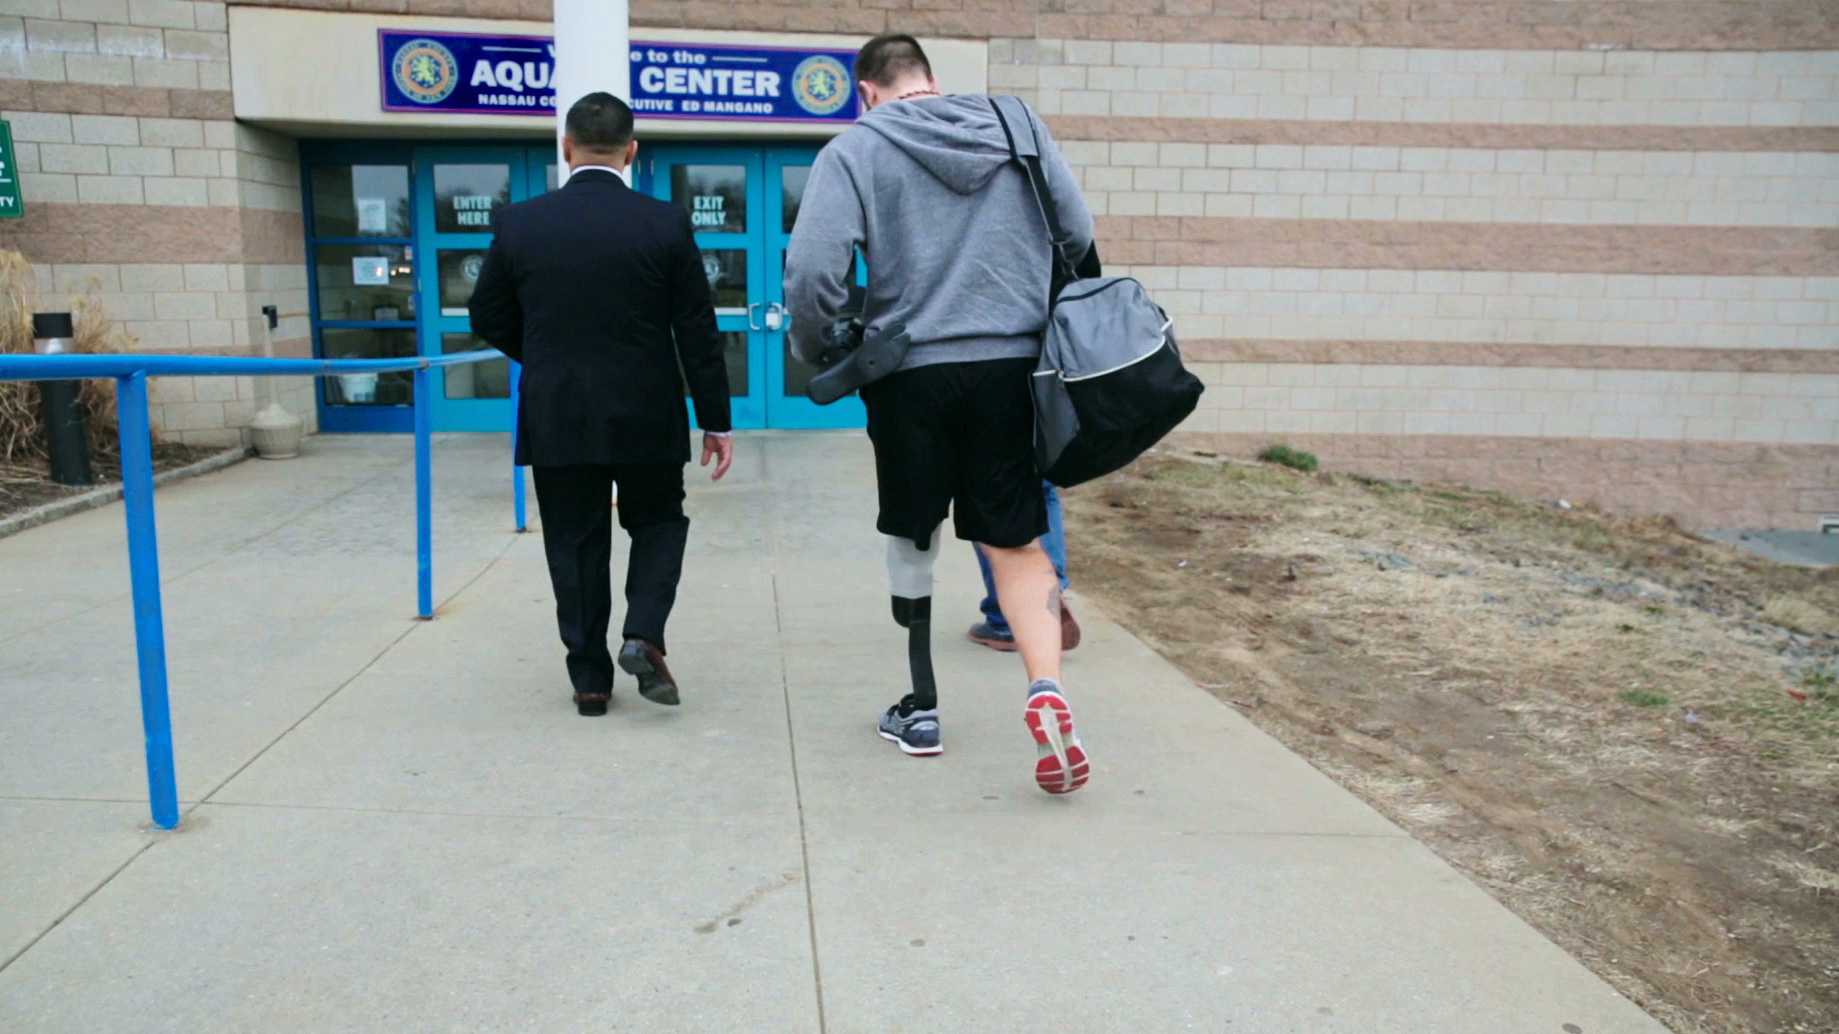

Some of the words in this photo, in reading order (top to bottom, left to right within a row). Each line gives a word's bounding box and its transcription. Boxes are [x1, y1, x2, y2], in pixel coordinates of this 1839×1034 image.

[646, 50, 668, 63] to
[673, 50, 706, 65] the
[470, 59, 556, 92] AQU
[639, 66, 781, 97] CENTER
[478, 94, 536, 107] NASSAU
[682, 100, 700, 112] ED
[704, 101, 773, 114] MANGANO
[453, 196, 492, 210] ENTER
[693, 196, 725, 210] EXIT
[457, 211, 490, 225] HERE
[691, 211, 727, 226] ONLY
